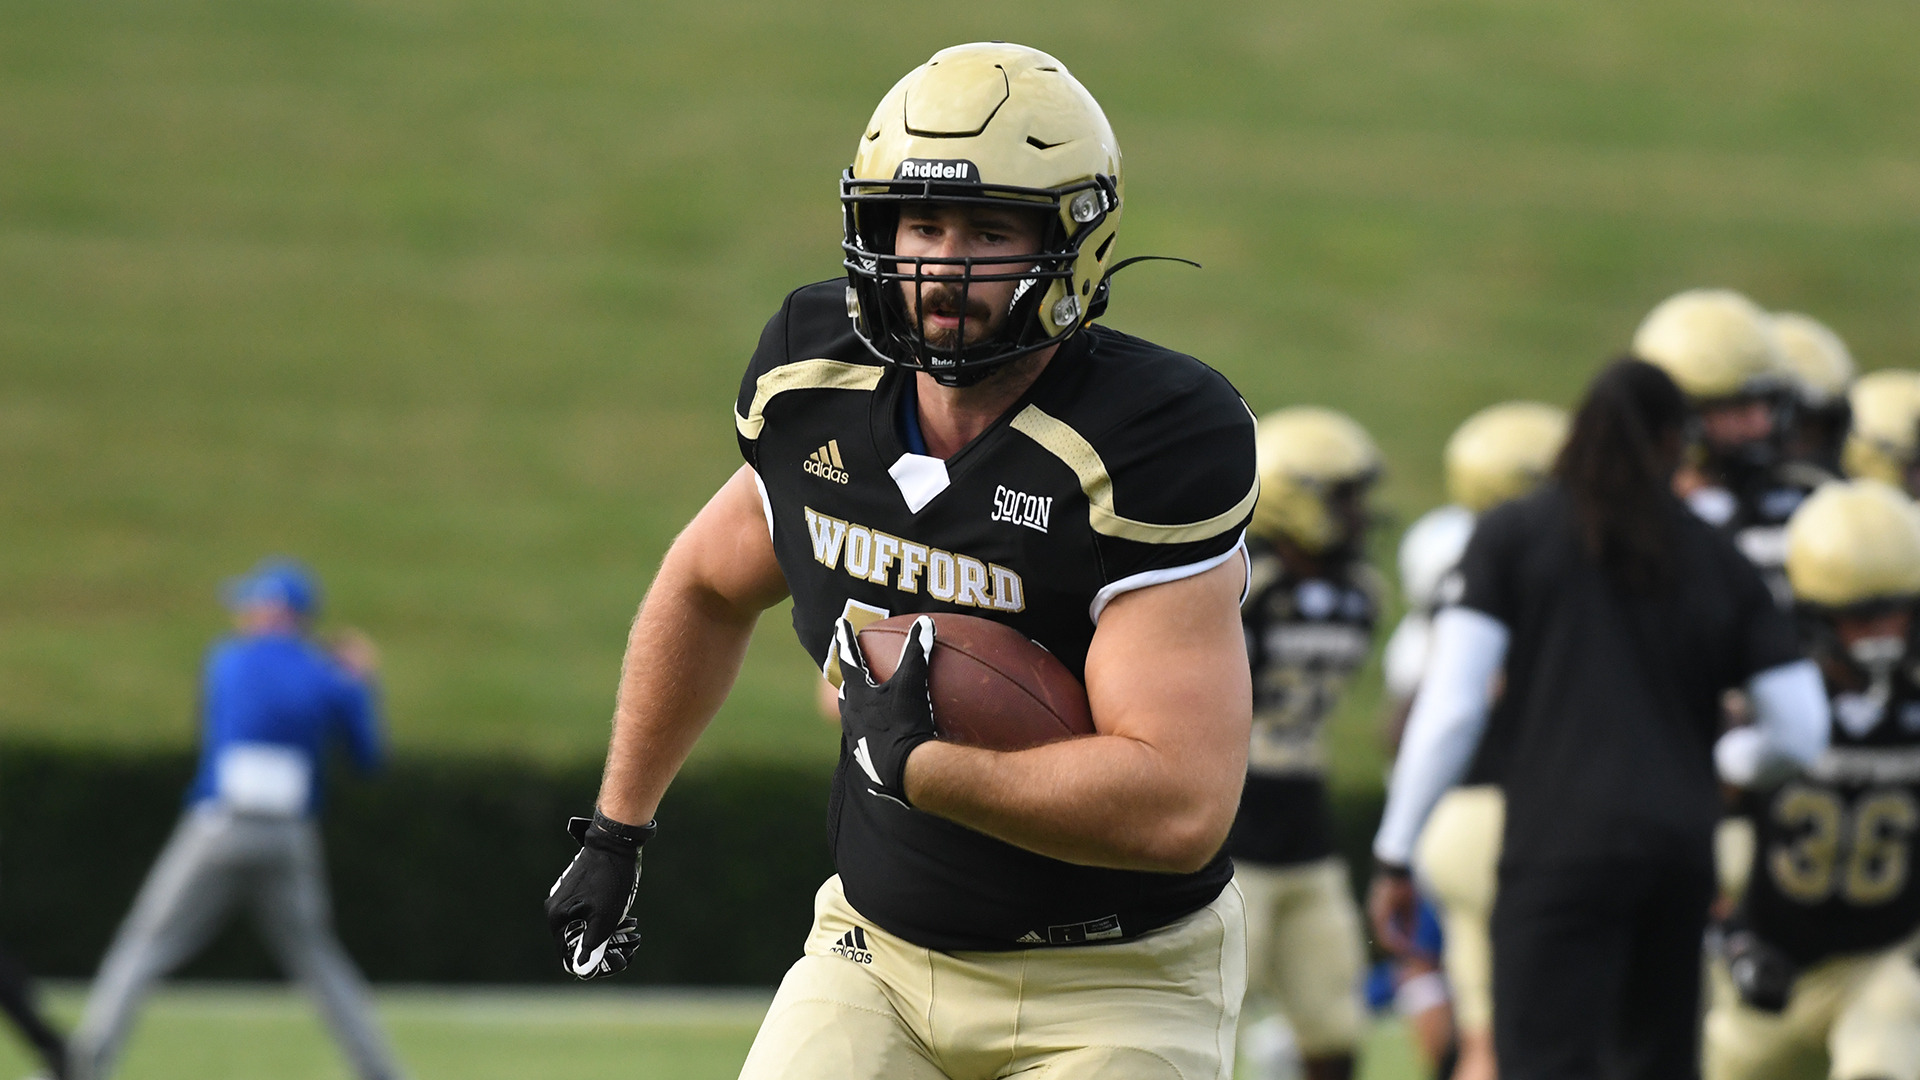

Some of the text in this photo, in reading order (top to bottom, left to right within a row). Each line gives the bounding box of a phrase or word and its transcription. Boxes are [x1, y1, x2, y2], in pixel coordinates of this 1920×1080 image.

[902, 161, 969, 179] Riddell
[803, 460, 850, 485] adidas
[991, 484, 1054, 534] SOCON
[804, 505, 1026, 614] WOFFORD
[1769, 786, 1918, 906] 36
